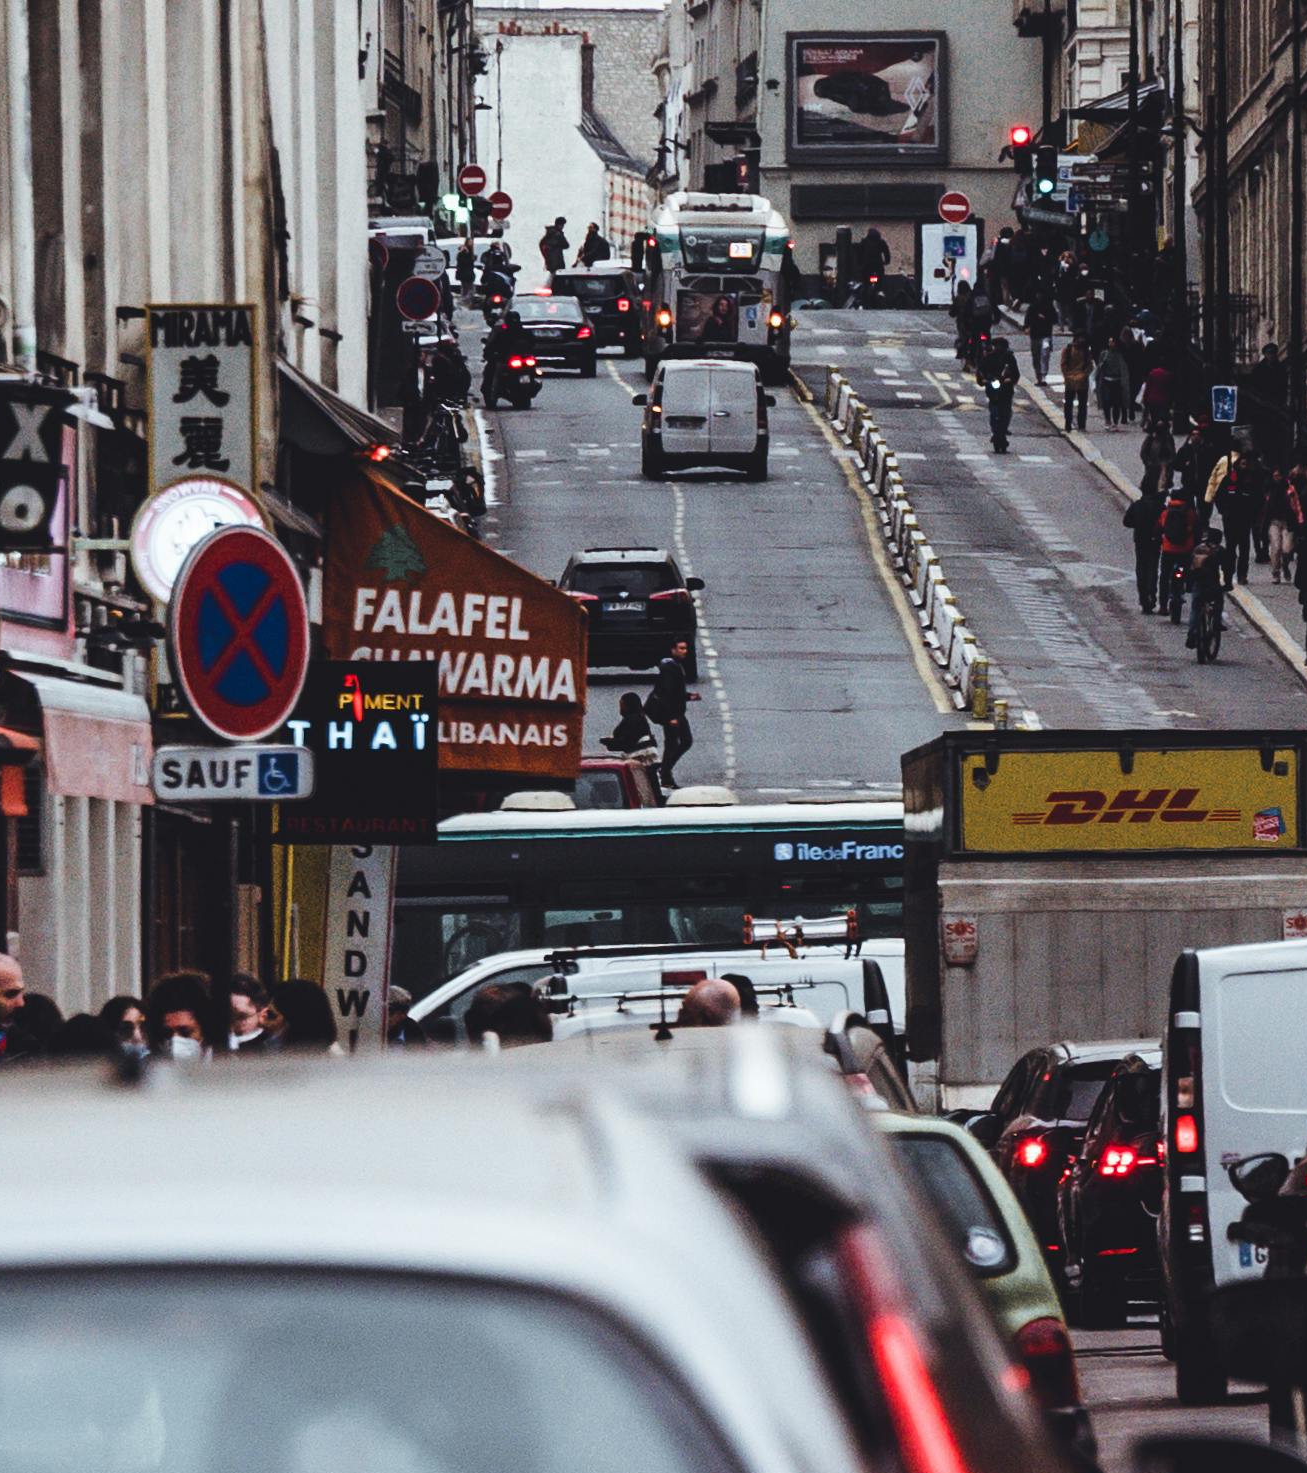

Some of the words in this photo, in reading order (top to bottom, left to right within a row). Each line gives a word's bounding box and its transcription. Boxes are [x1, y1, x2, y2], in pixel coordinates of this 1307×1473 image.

[151, 311, 252, 348] MIRAMA
[354, 587, 530, 641] FALAFEL
[350, 646, 577, 703] WARMA
[287, 713, 430, 750] THAÏ
[437, 721, 568, 747] LIBANAIS
[162, 759, 252, 789] SAUF
[287, 817, 429, 833] RESTAURANT
[1043, 788, 1210, 825] DHL
